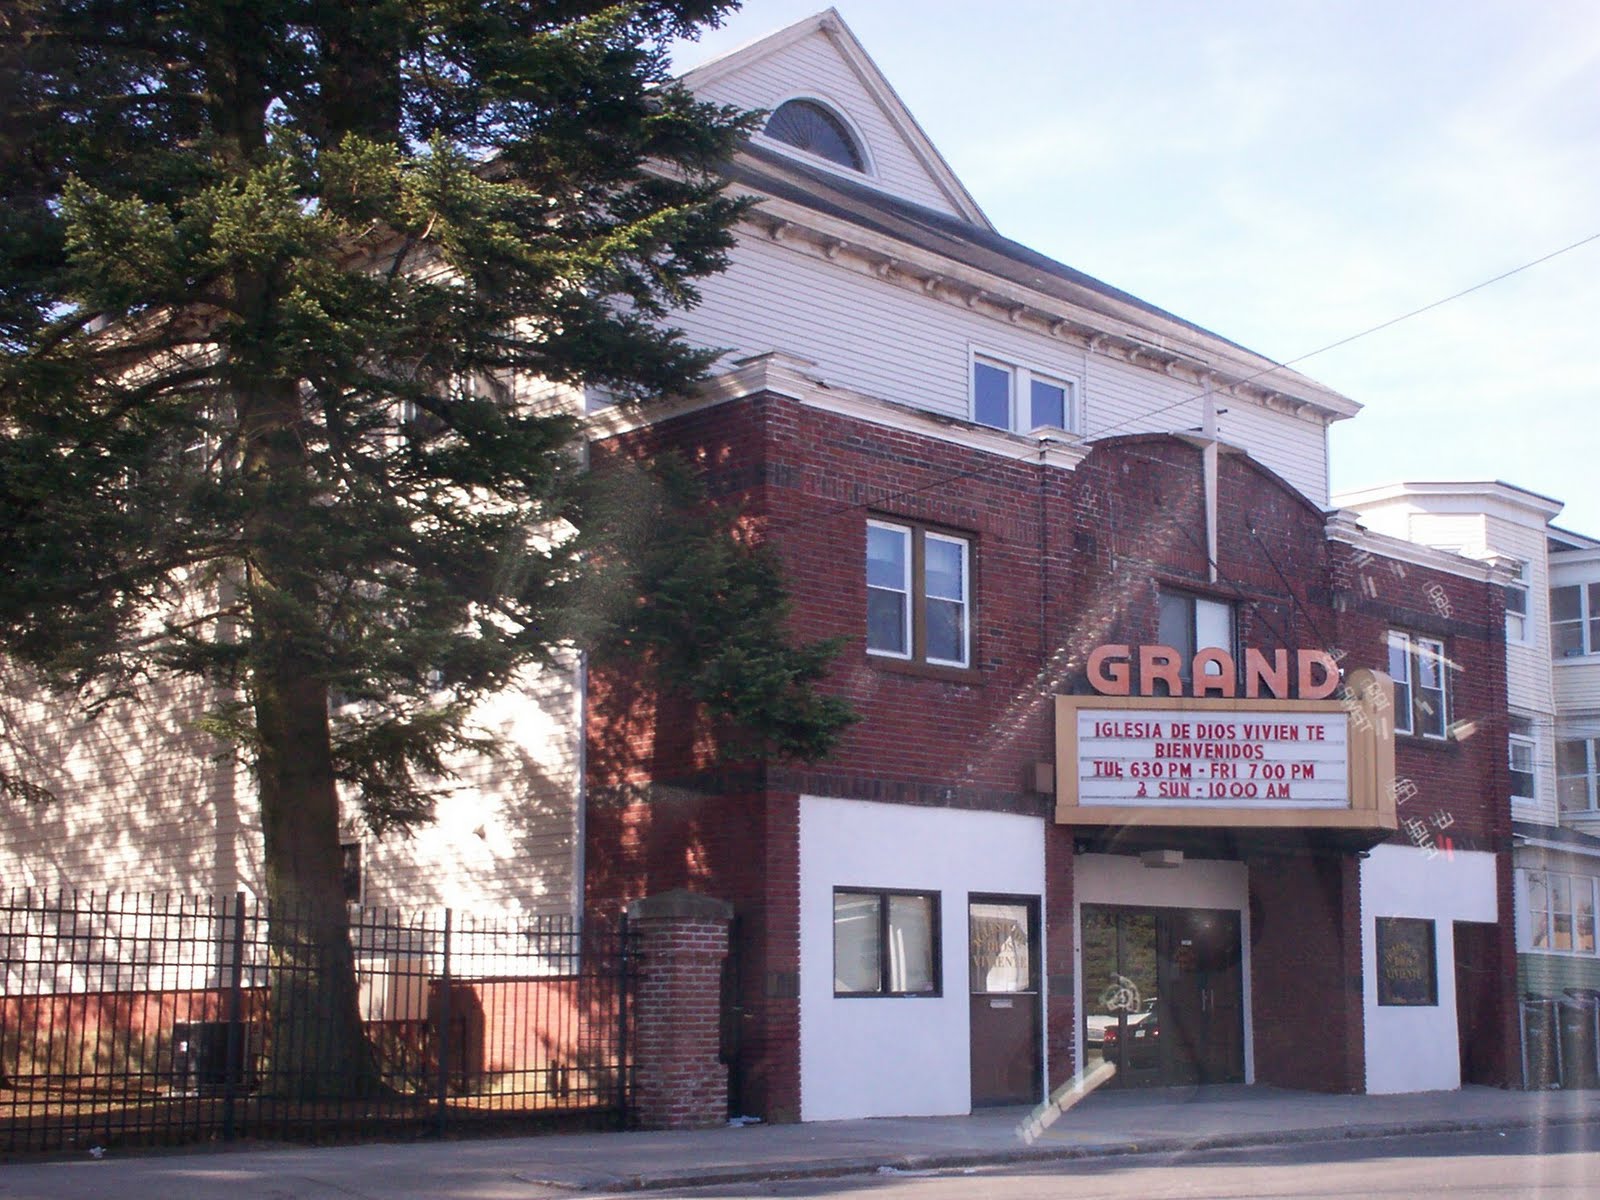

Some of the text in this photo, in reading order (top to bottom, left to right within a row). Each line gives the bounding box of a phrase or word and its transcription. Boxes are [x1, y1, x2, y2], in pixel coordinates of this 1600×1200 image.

[1086, 644, 1340, 699] GRAND
[1095, 721, 1163, 739] IGLESIA
[1171, 723, 1191, 740] DE
[1196, 723, 1237, 740] DIOS
[1155, 742, 1264, 760] BIENVENIDOS
[1130, 762, 1163, 778] 630
[1168, 762, 1192, 779] PM
[1210, 763, 1237, 779] FRI
[1291, 763, 1315, 780] PM
[1158, 782, 1190, 798] SUN
[1265, 782, 1291, 799] AM
